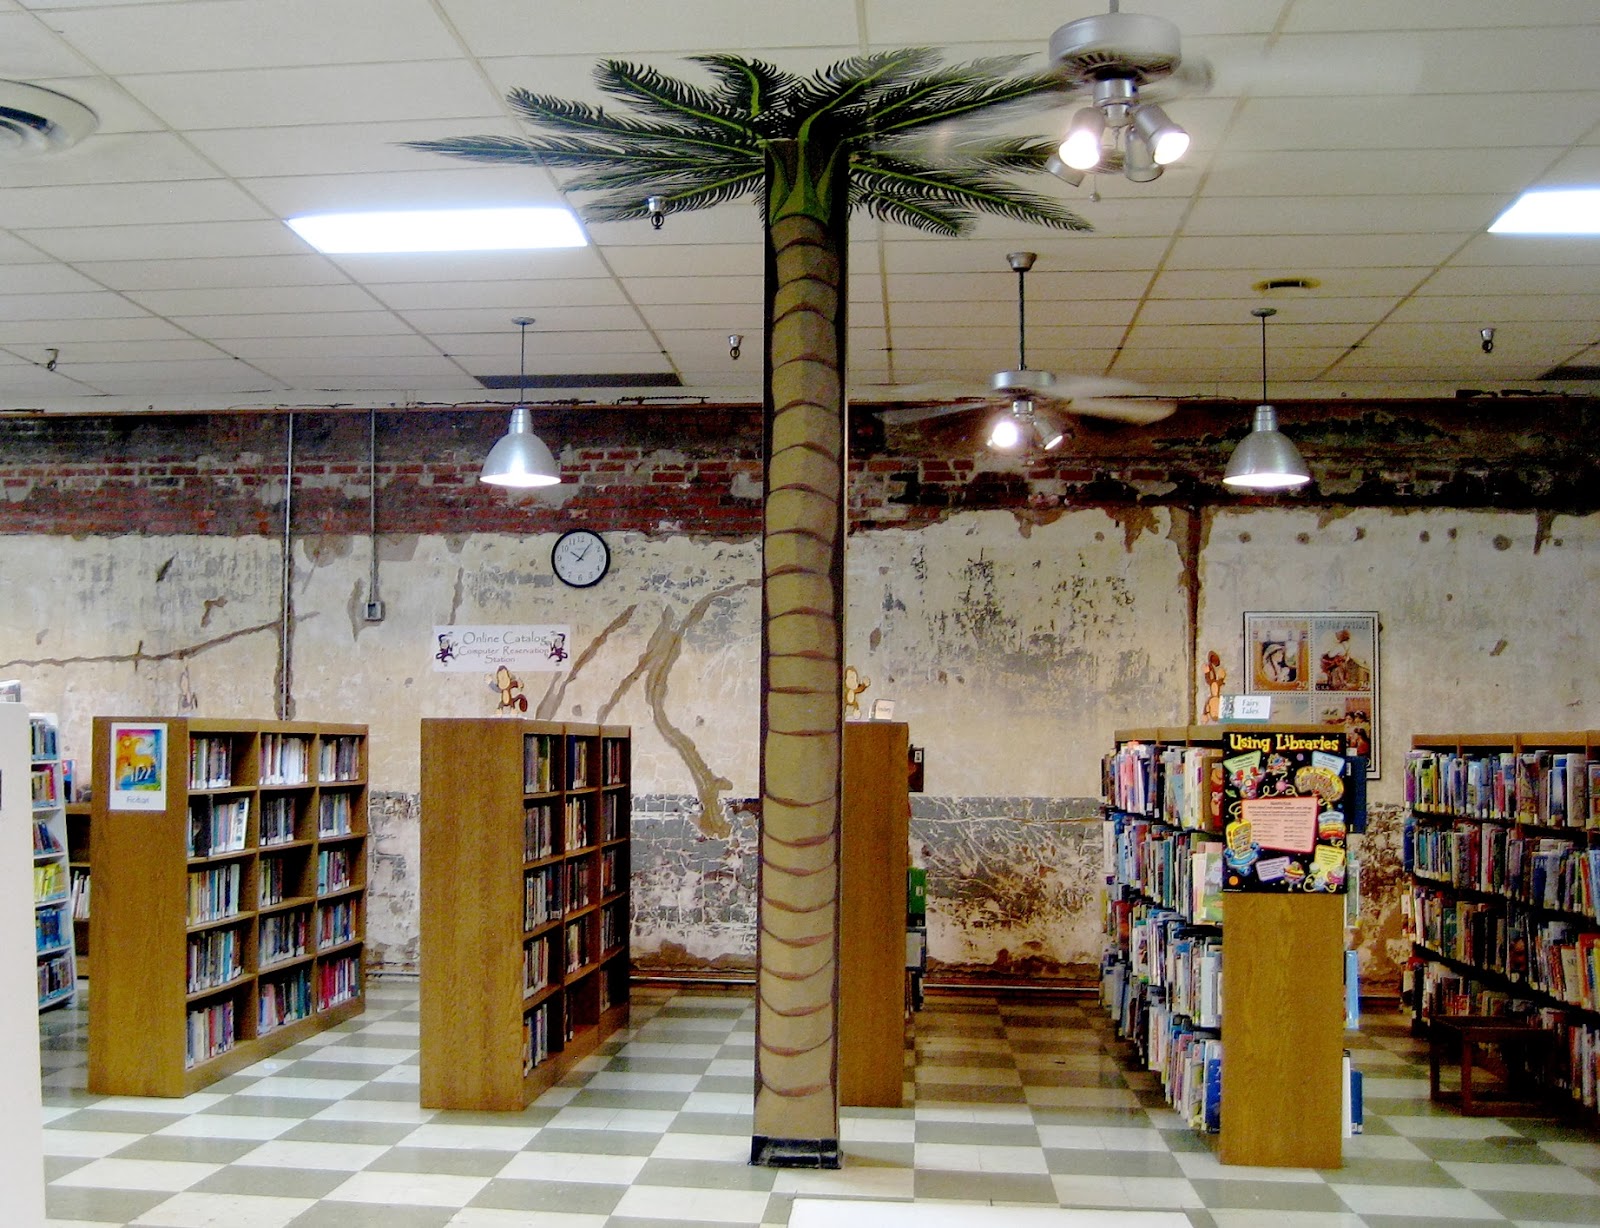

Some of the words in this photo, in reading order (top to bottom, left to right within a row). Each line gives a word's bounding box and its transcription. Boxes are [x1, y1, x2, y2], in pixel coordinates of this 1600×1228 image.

[462, 631, 499, 645] Online
[502, 631, 549, 647] Catalog
[458, 645, 499, 656] Computer
[502, 645, 549, 656] Reservation
[484, 654, 516, 664] Station
[1242, 698, 1260, 708] Fairy
[1241, 706, 1260, 715] Tales
[1229, 733, 1271, 753] Using
[1275, 733, 1340, 751] Libraries
